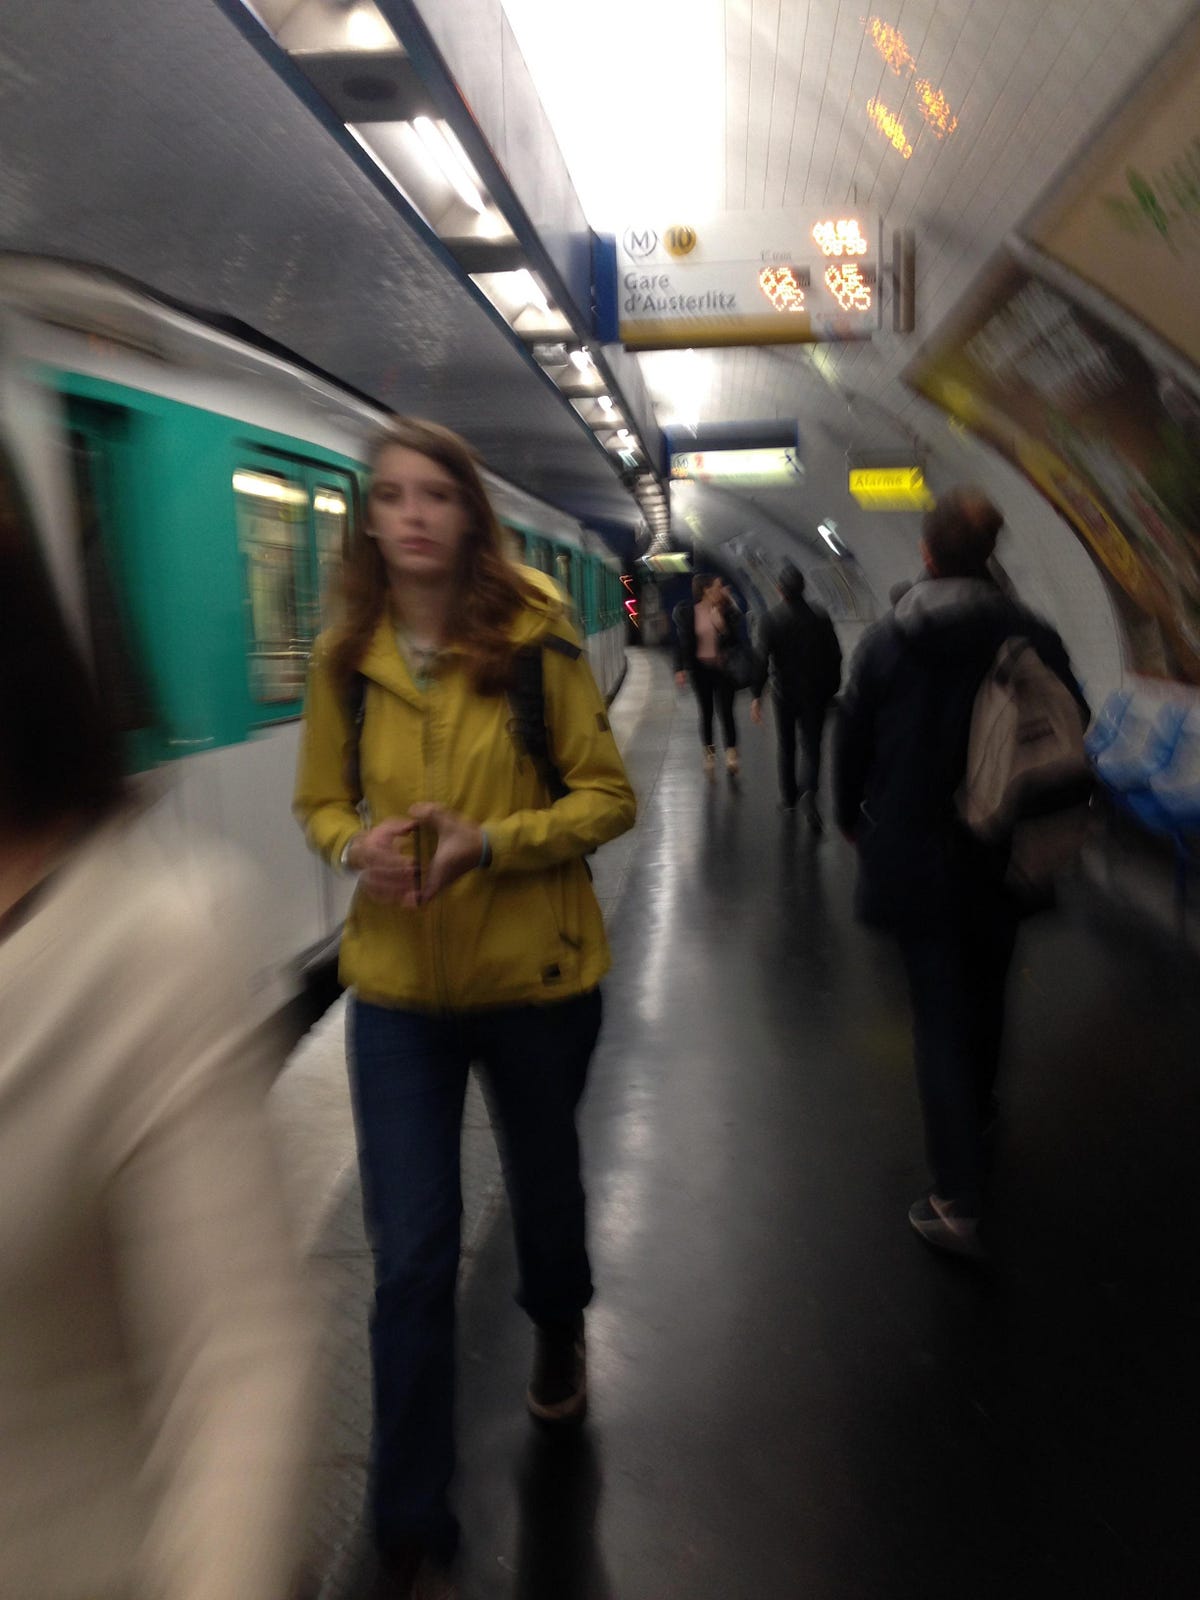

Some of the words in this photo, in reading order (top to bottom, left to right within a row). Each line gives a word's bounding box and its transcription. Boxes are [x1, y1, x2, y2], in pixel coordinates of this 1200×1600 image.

[669, 226, 694, 250] 10
[623, 272, 670, 291] Gare
[624, 290, 736, 313] d'Austerlitz
